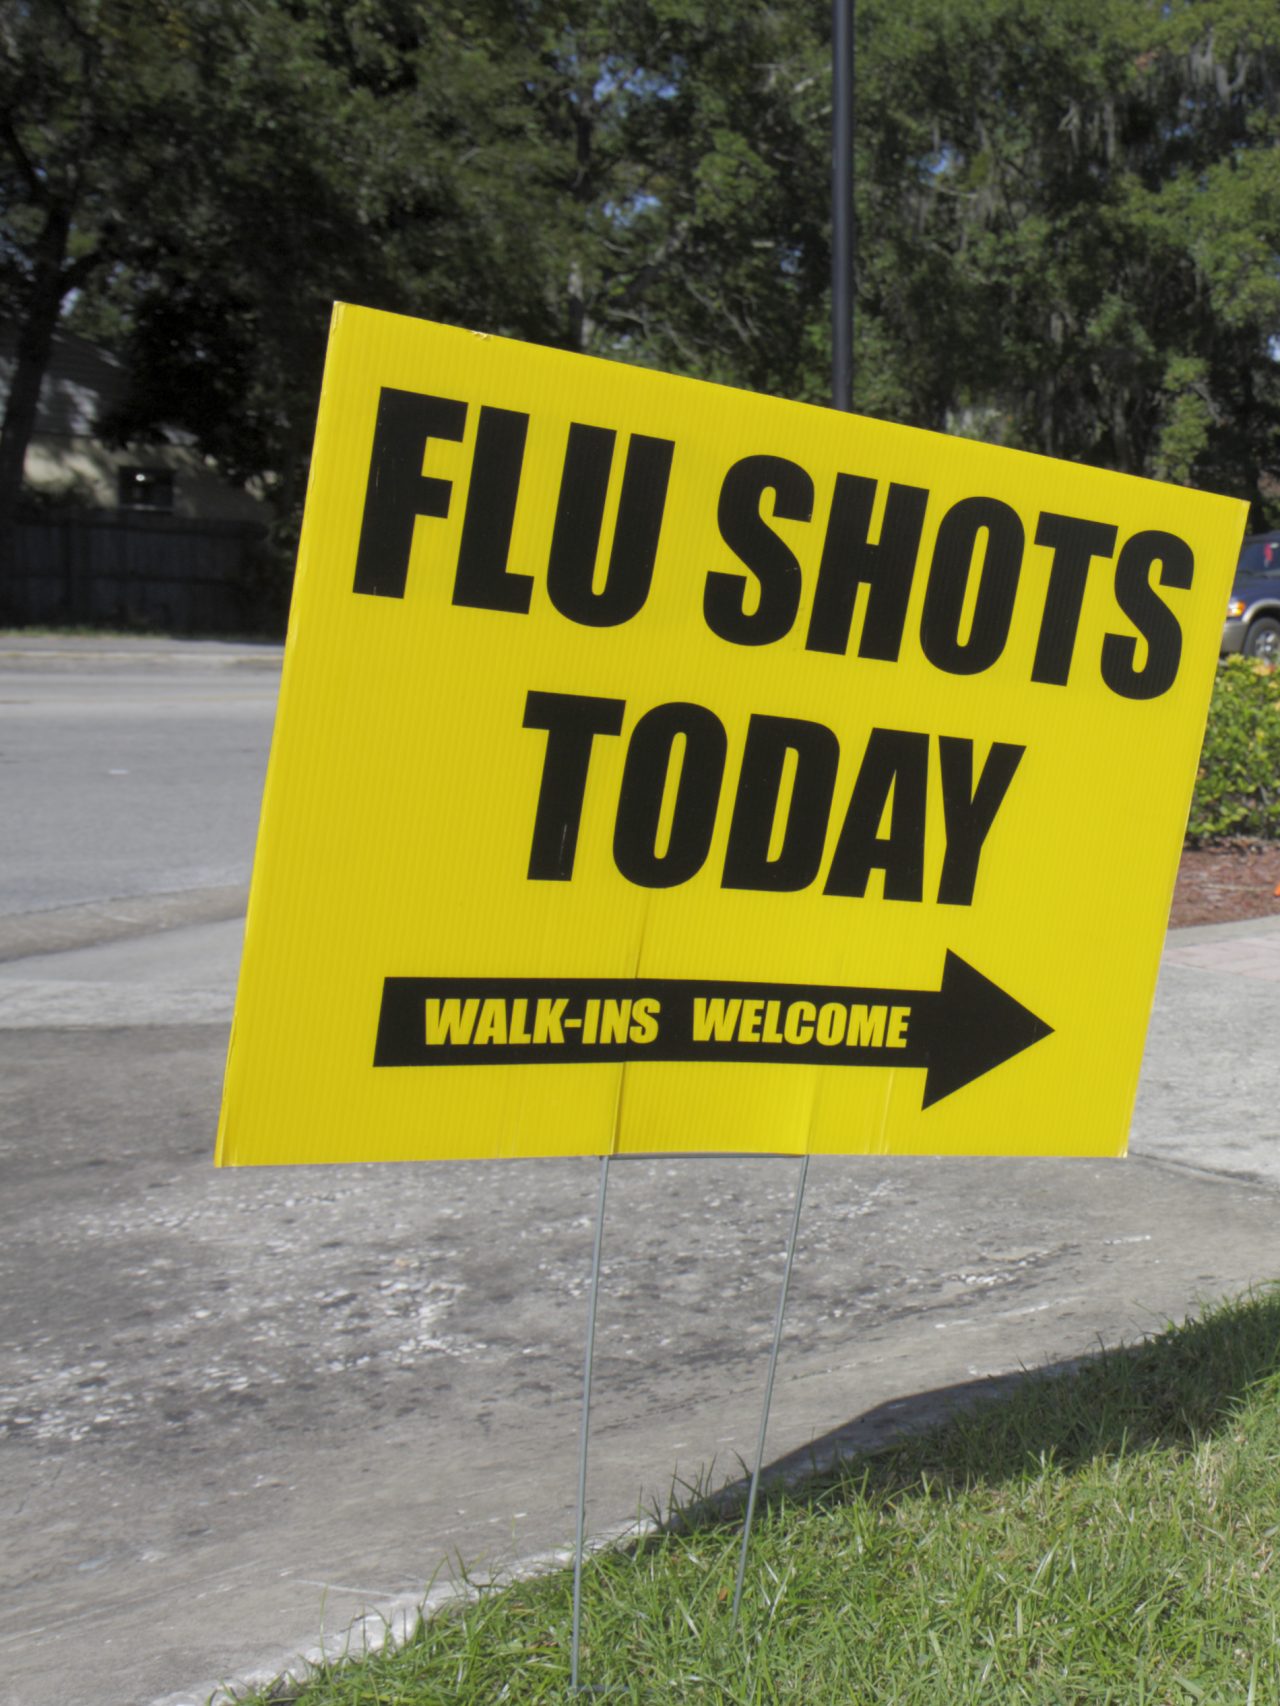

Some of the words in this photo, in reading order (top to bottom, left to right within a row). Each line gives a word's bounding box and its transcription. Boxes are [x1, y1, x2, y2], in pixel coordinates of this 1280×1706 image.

[353, 386, 674, 627] FLU
[704, 455, 1193, 699] SHOTS
[523, 691, 1025, 905] TODAY
[425, 998, 660, 1045] WALK-INS
[692, 998, 911, 1048] WELCOME
